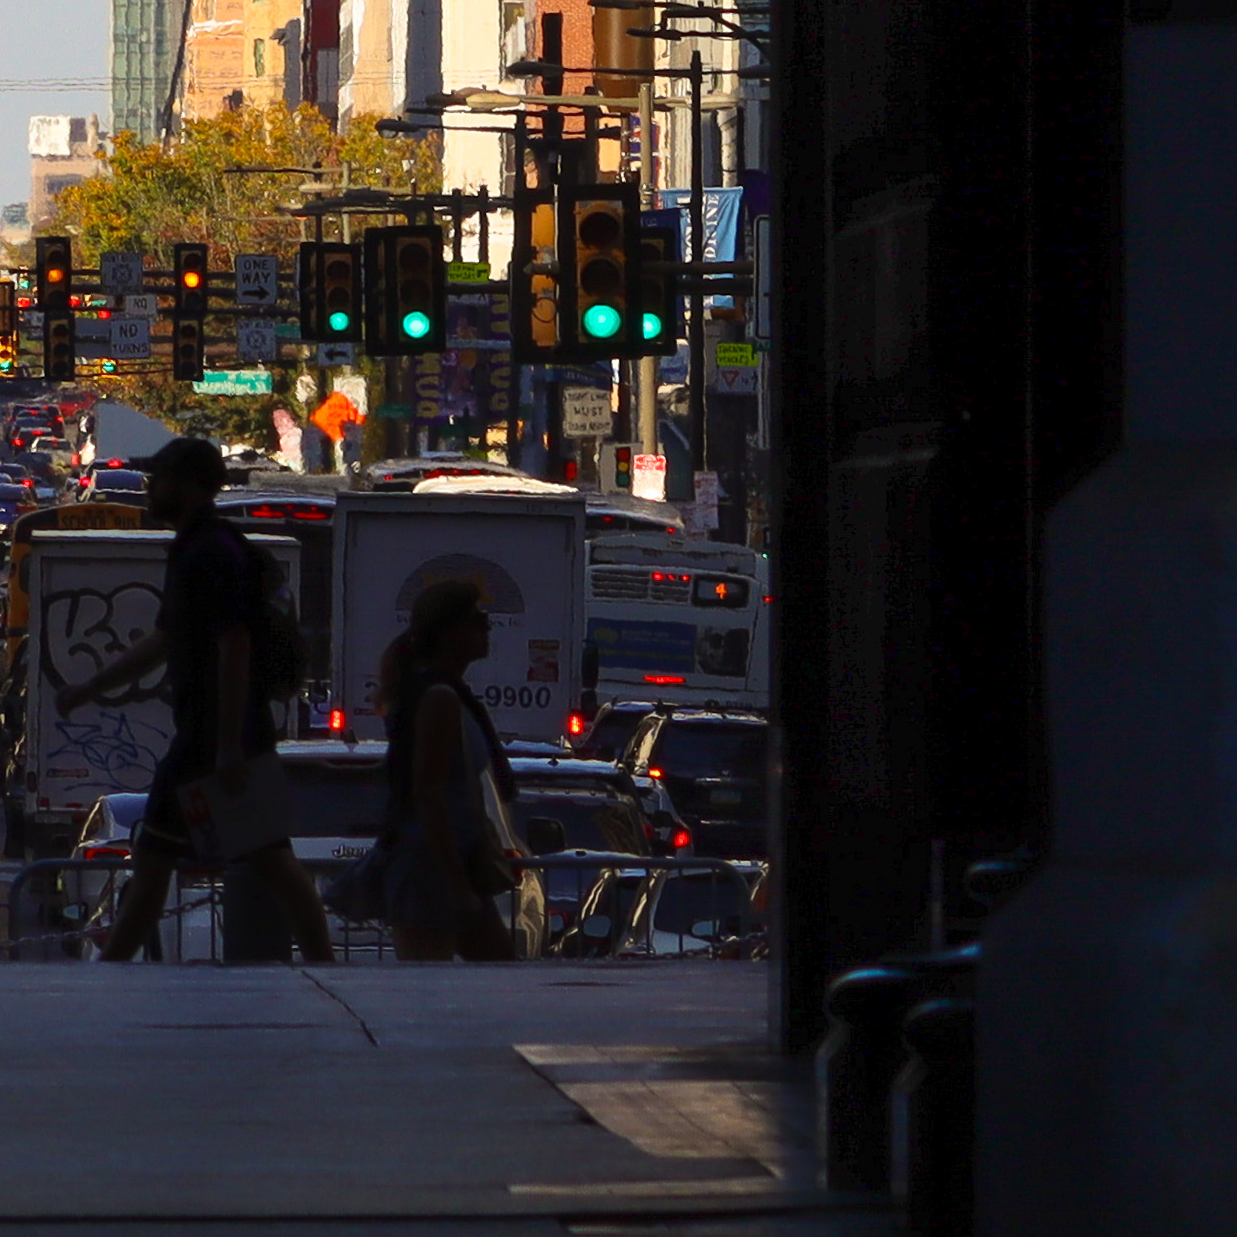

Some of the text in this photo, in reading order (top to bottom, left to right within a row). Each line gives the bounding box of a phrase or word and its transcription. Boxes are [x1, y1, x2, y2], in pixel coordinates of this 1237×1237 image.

[243, 260, 269, 270] ONE
[242, 272, 271, 283] WAY
[120, 324, 138, 338] NO
[113, 343, 147, 353] TURNS
[715, 582, 728, 600] 4
